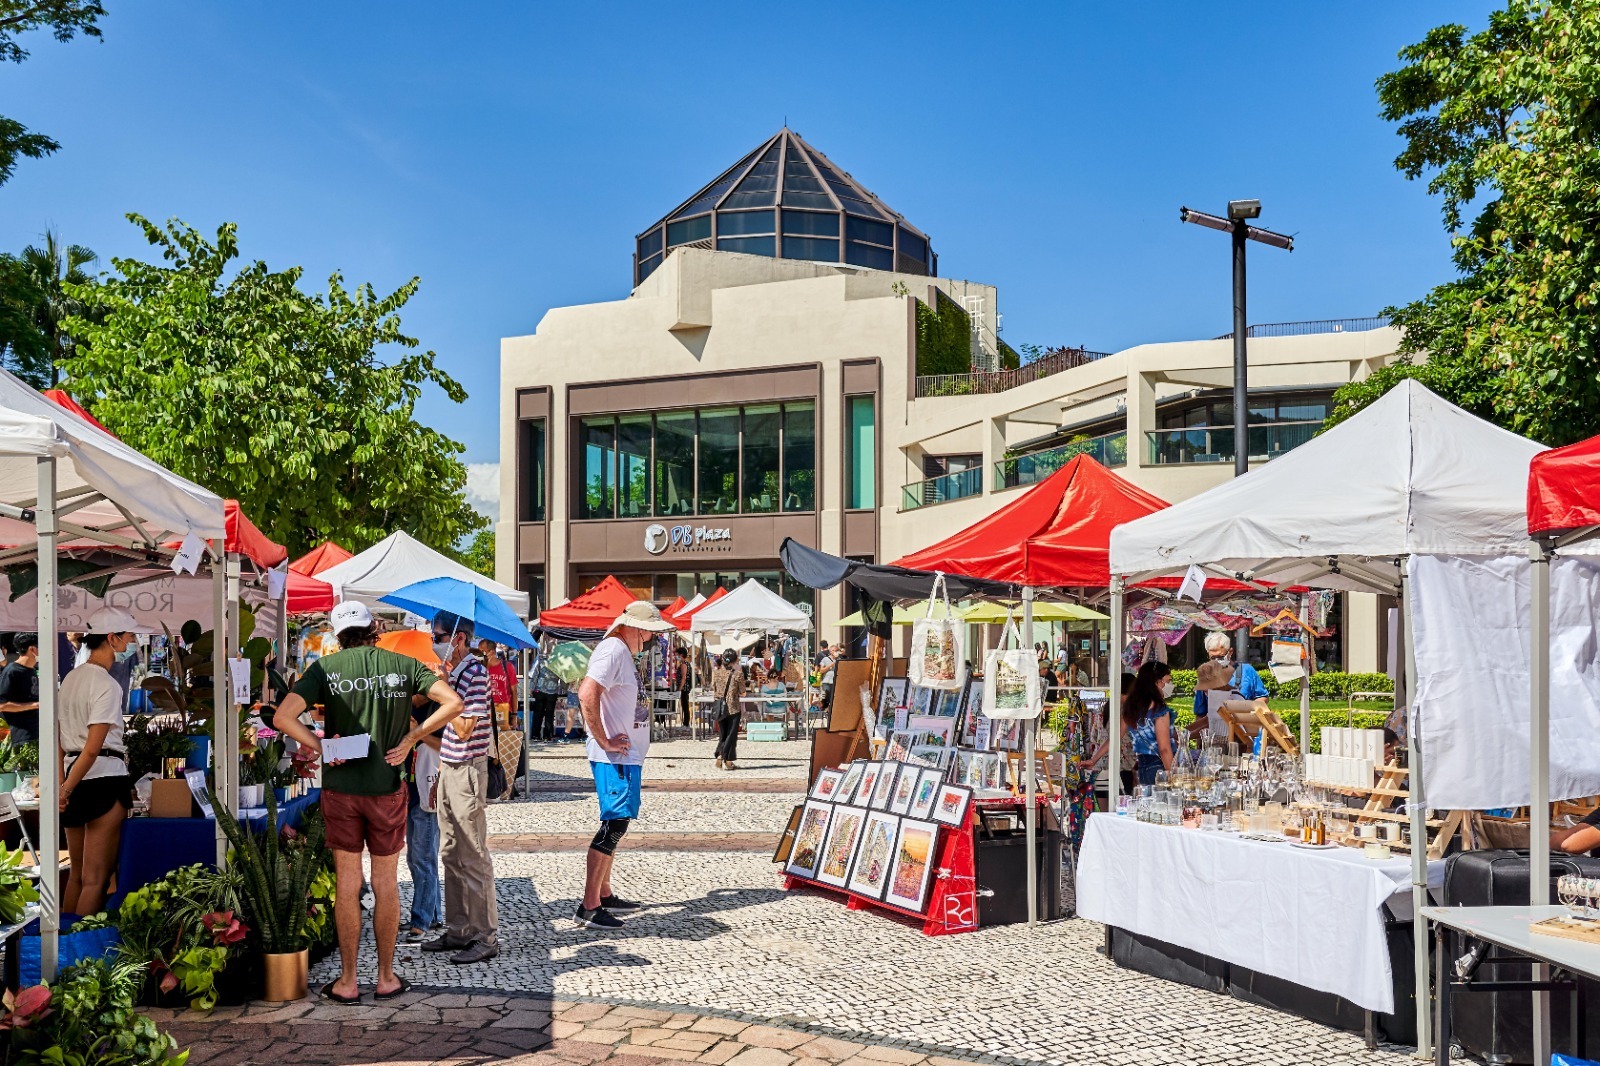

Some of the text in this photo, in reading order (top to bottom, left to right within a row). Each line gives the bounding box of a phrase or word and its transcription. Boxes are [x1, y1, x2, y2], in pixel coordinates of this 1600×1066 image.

[670, 525, 693, 545] DB
[326, 671, 342, 682] My
[382, 690, 407, 699] Green
